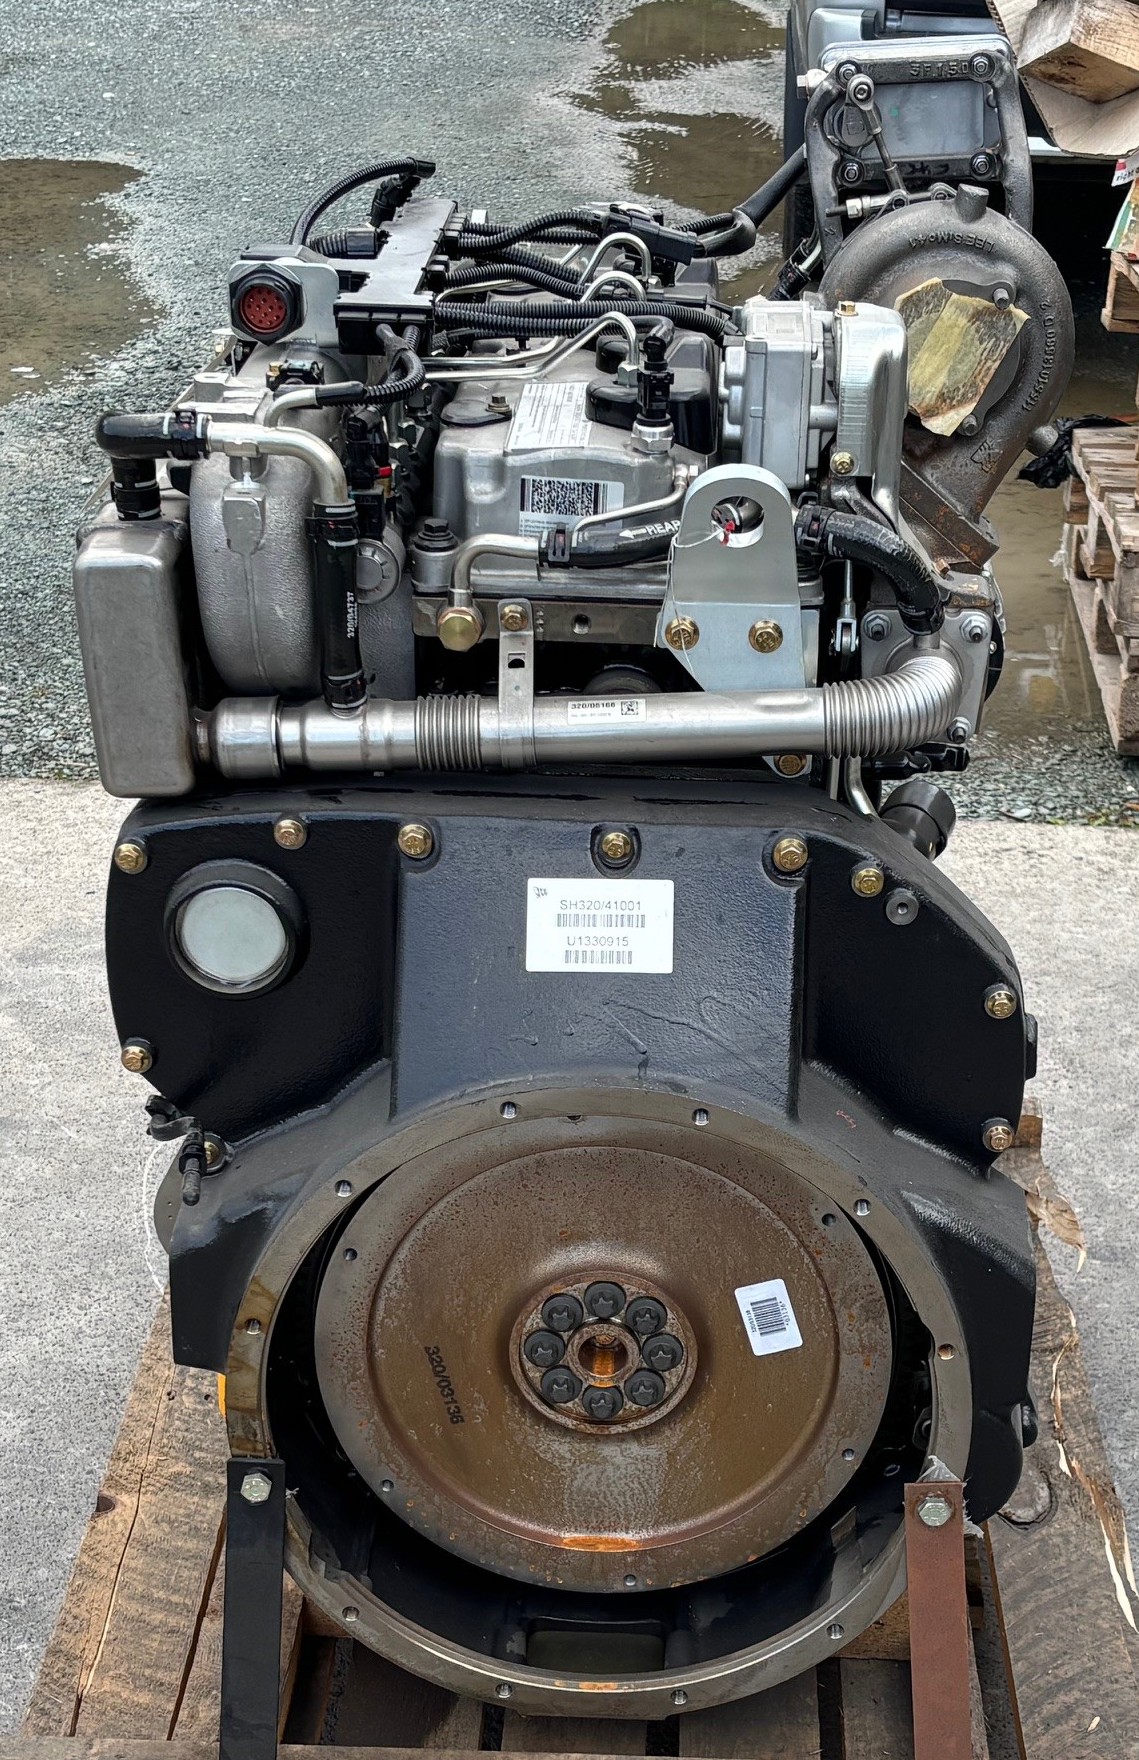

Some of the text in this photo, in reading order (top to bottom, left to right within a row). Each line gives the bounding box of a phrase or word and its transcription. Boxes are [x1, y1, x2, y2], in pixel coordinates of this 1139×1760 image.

[560, 899, 642, 911] SH320/41001
[567, 936, 629, 947] U1330915
[424, 1346, 465, 1424] 320/03136
